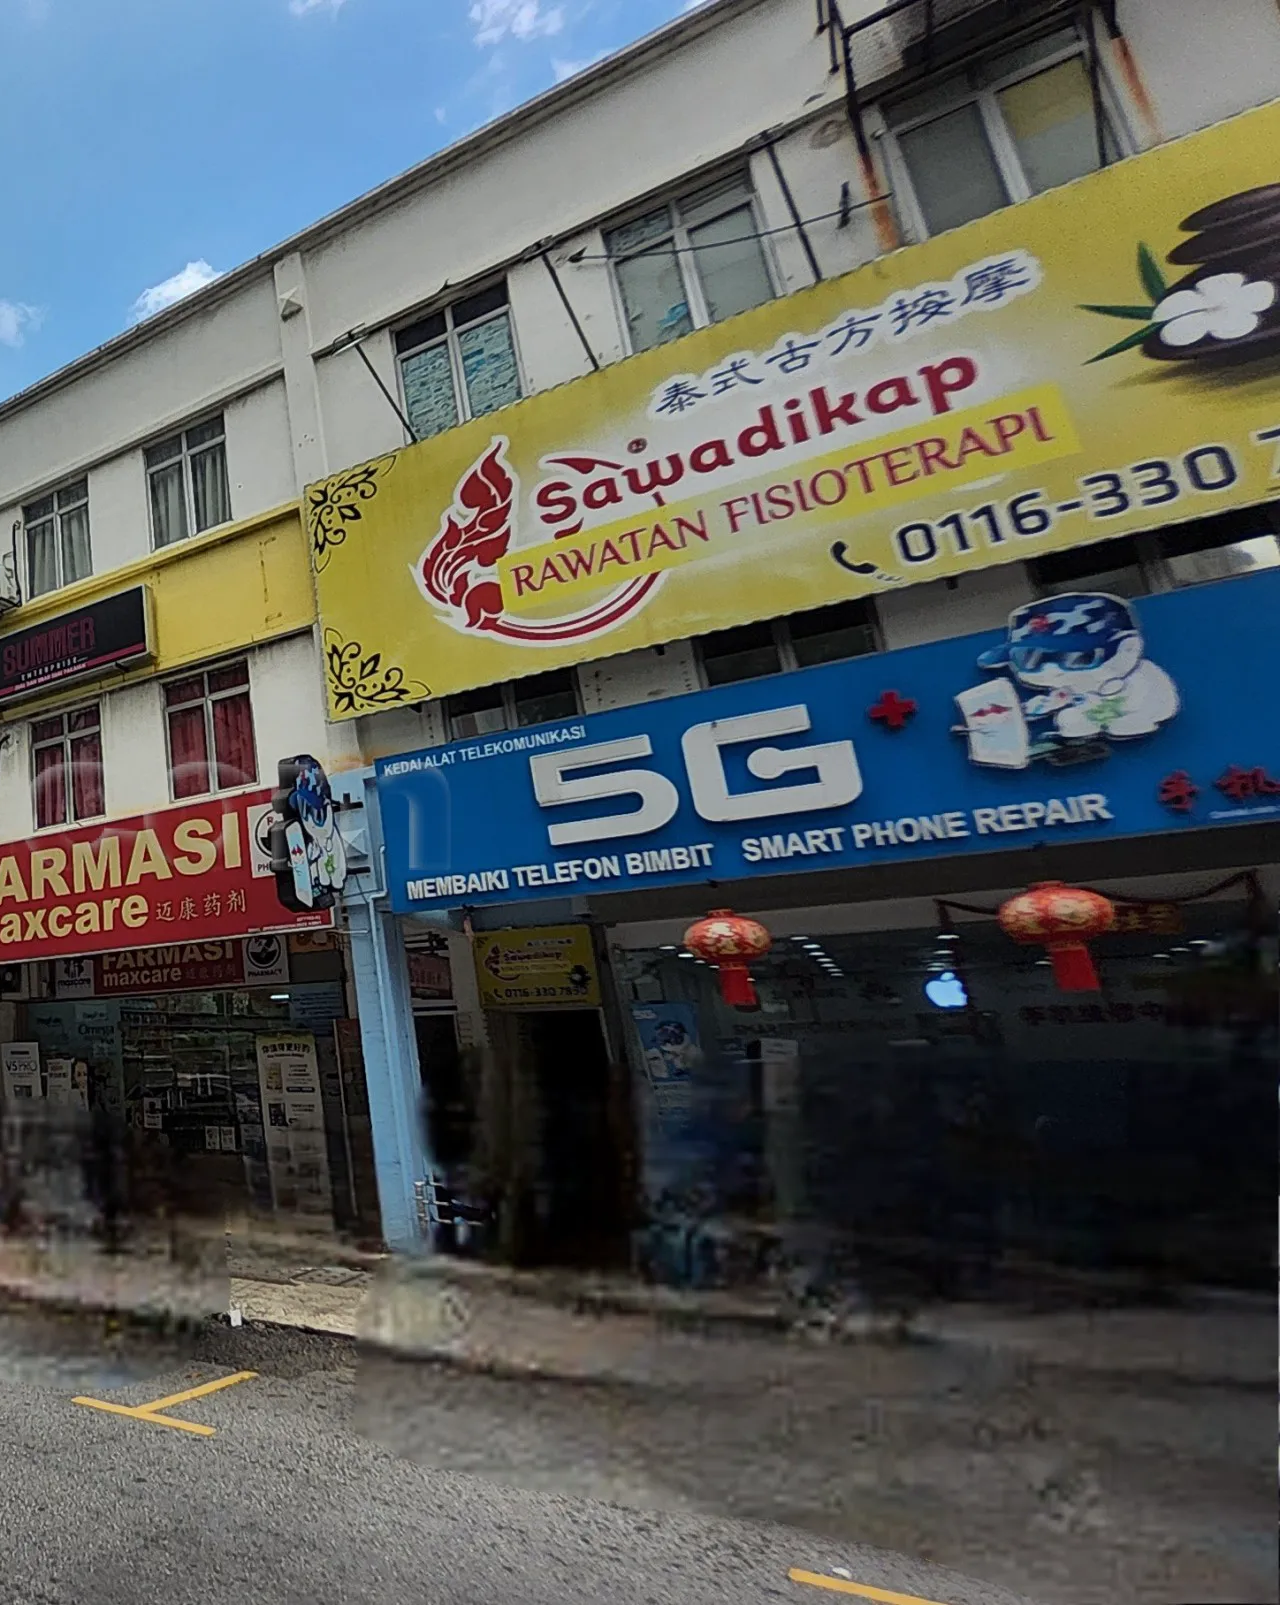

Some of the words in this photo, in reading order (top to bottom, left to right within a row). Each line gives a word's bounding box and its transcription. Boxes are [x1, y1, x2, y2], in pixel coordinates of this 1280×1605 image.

[655, 255, 1032, 415] 泰式古方按摩
[536, 355, 979, 526] Sawadikap
[513, 510, 709, 598] RAWATAN
[725, 408, 1055, 536] FISIOTERAPI
[896, 445, 1238, 563] 0116-330
[3, 617, 95, 677] SUMMER
[384, 761, 421, 777] KEDAI
[423, 751, 456, 768] ALAT
[459, 724, 587, 763] TELEKOMUNIKASI
[529, 703, 864, 847] 5G
[740, 826, 847, 863] SMART
[851, 811, 971, 850] PHONE
[972, 793, 1115, 835] REPAIR
[406, 869, 510, 901] MEMBAIKI
[511, 854, 622, 888] TELEFON
[624, 843, 715, 876] BIMBIT
[155, 889, 247, 923] 迈康药剂
[101, 941, 235, 970] FARMASI
[103, 966, 183, 988] maxcare
[248, 968, 283, 978] PHARMACY
